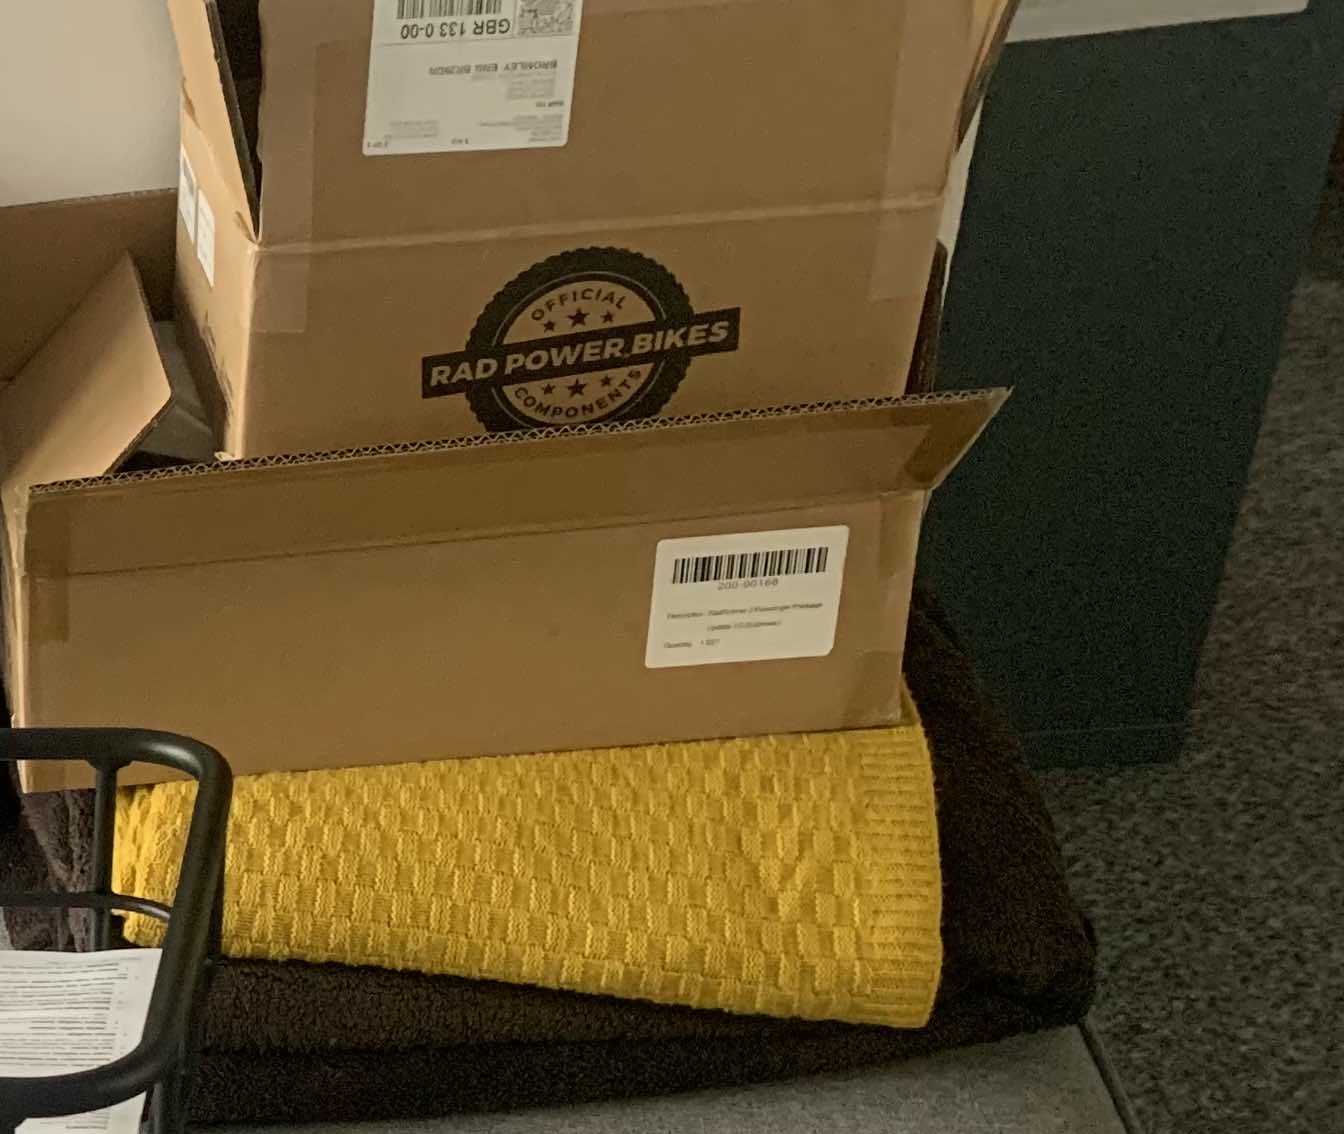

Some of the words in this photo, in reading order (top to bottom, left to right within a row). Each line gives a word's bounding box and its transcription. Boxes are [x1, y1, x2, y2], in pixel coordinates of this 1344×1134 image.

[439, 22, 465, 37] 133
[473, 18, 511, 35] GBR
[530, 287, 628, 322] OFFICIAL
[430, 357, 498, 387] RAD
[505, 337, 625, 375] POWER
[632, 320, 730, 355] BIKES
[514, 367, 642, 419] COMPONENTS
